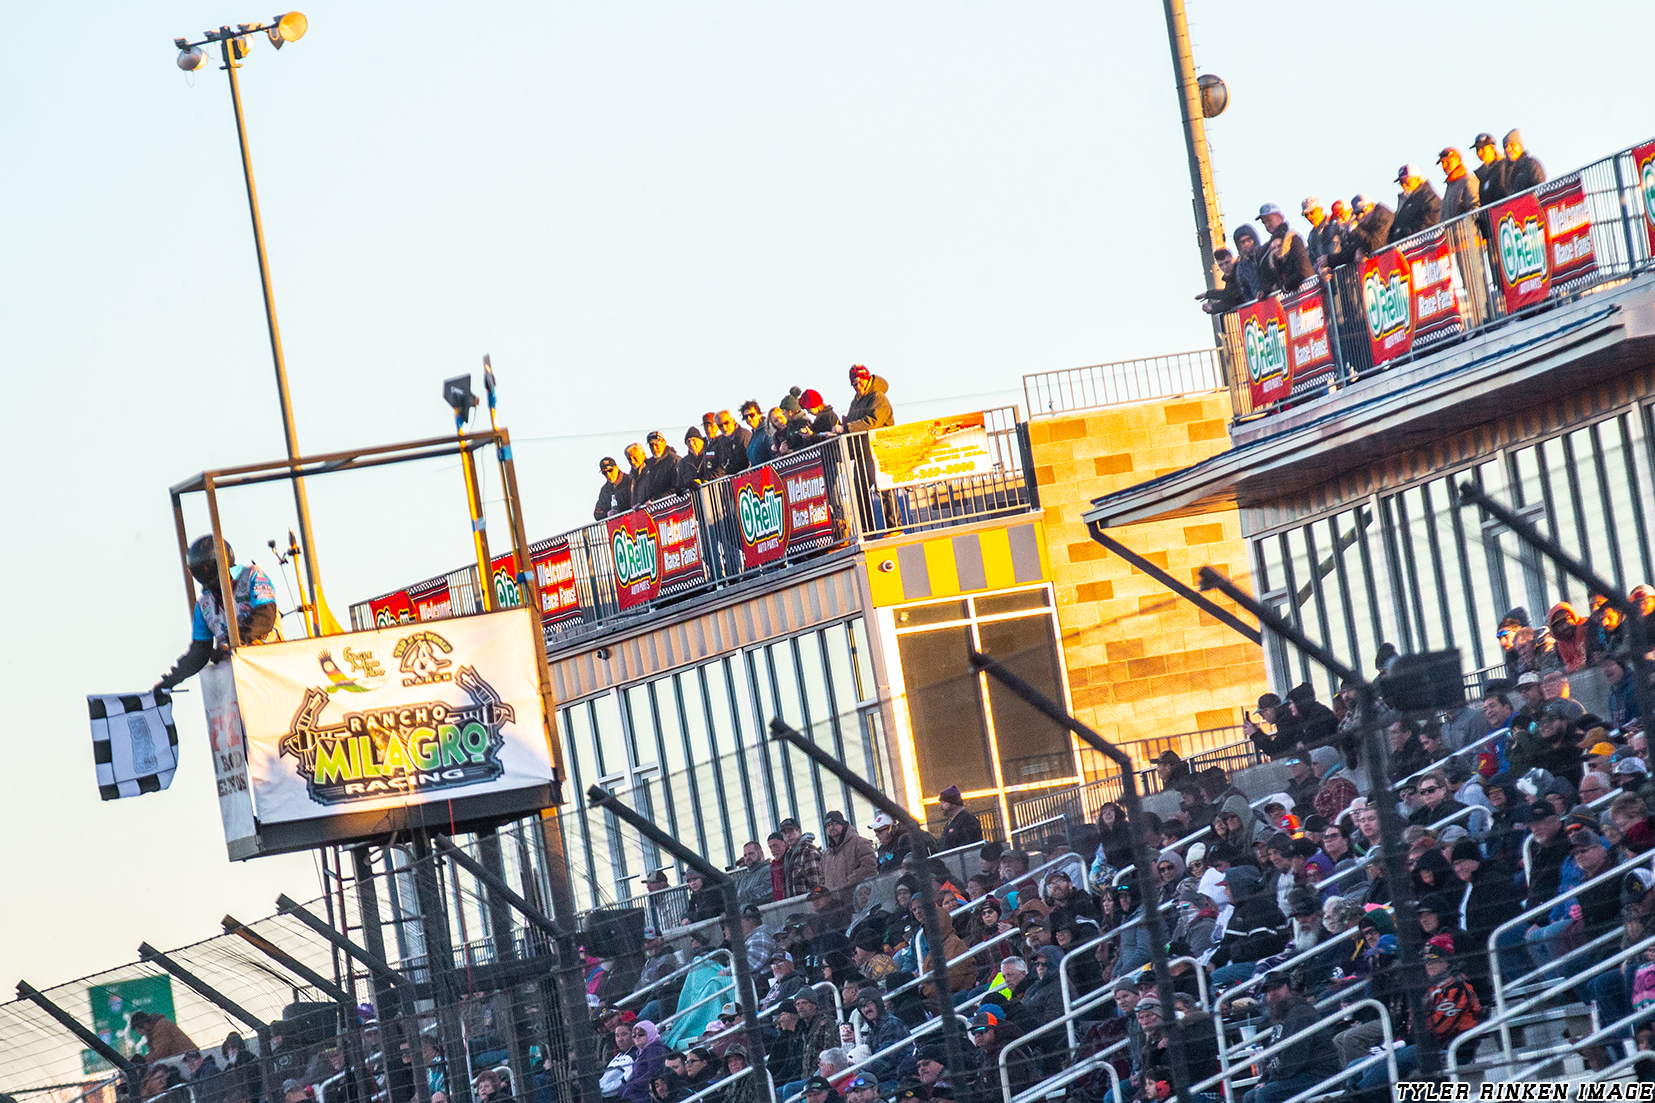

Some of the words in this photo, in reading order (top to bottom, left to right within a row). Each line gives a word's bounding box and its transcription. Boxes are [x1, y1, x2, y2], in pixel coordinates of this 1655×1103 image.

[1500, 217, 1547, 282] O'Reilly
[1364, 273, 1410, 335] O'Reilly
[1245, 320, 1288, 380] O'Reilly
[892, 460, 975, 484] 602-269-8000
[787, 476, 825, 504] Welcome
[739, 488, 782, 541] O'Reilly
[792, 509, 809, 529] Race
[809, 500, 828, 523] Fans!
[659, 516, 696, 547] Welcome
[614, 530, 657, 583] O'Reilly
[664, 551, 680, 572] Race
[680, 542, 698, 566] Fans!
[536, 560, 573, 587] Welcome
[541, 591, 559, 612] Race
[403, 673, 451, 686] RANCH
[351, 706, 446, 732] RANCHO
[314, 722, 488, 785] MILAGRO
[344, 768, 465, 795] RACING
